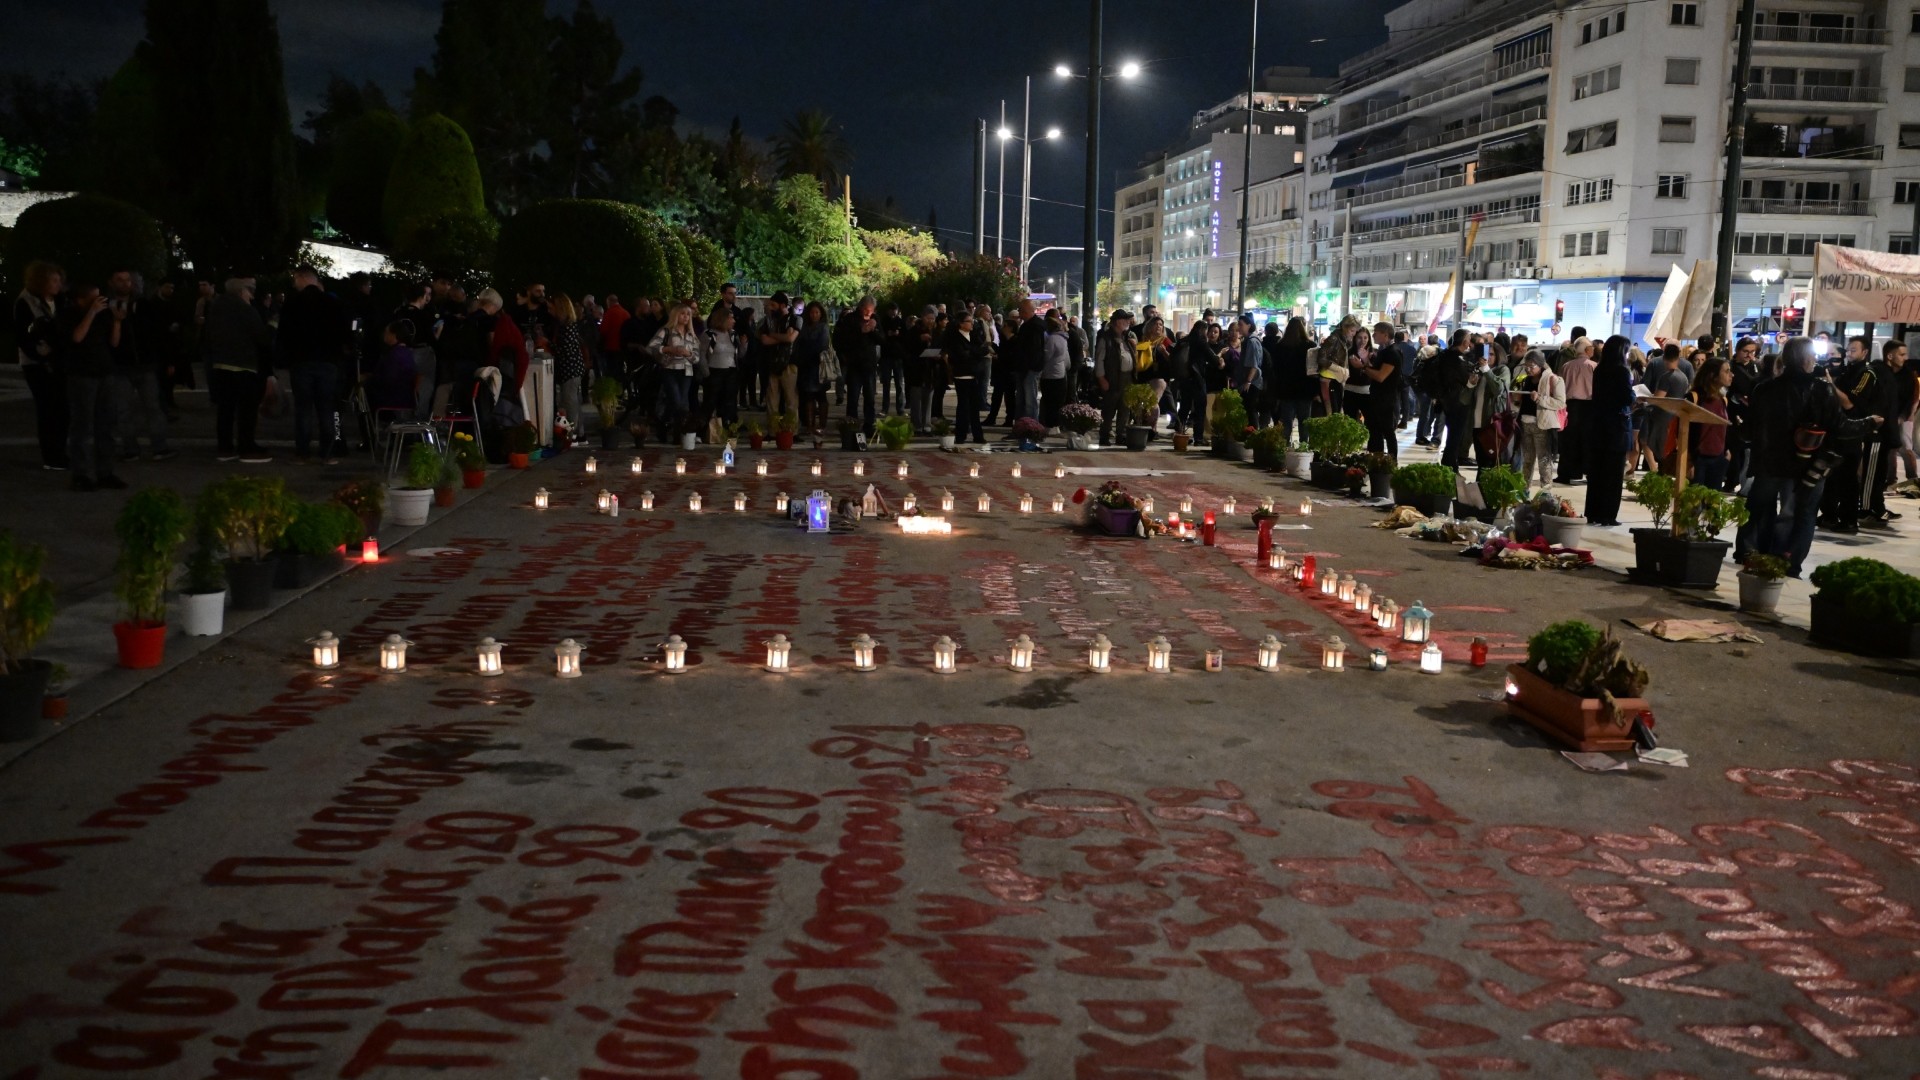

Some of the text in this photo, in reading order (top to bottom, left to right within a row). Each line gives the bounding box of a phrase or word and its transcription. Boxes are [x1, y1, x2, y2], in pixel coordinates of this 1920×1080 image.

[1212, 165, 1222, 257] HOTEL AMALIA
[811, 724, 936, 758] 21
[682, 788, 820, 832] 20
[1147, 781, 1258, 824] 22
[405, 811, 535, 851] 20
[518, 825, 651, 867] 20
